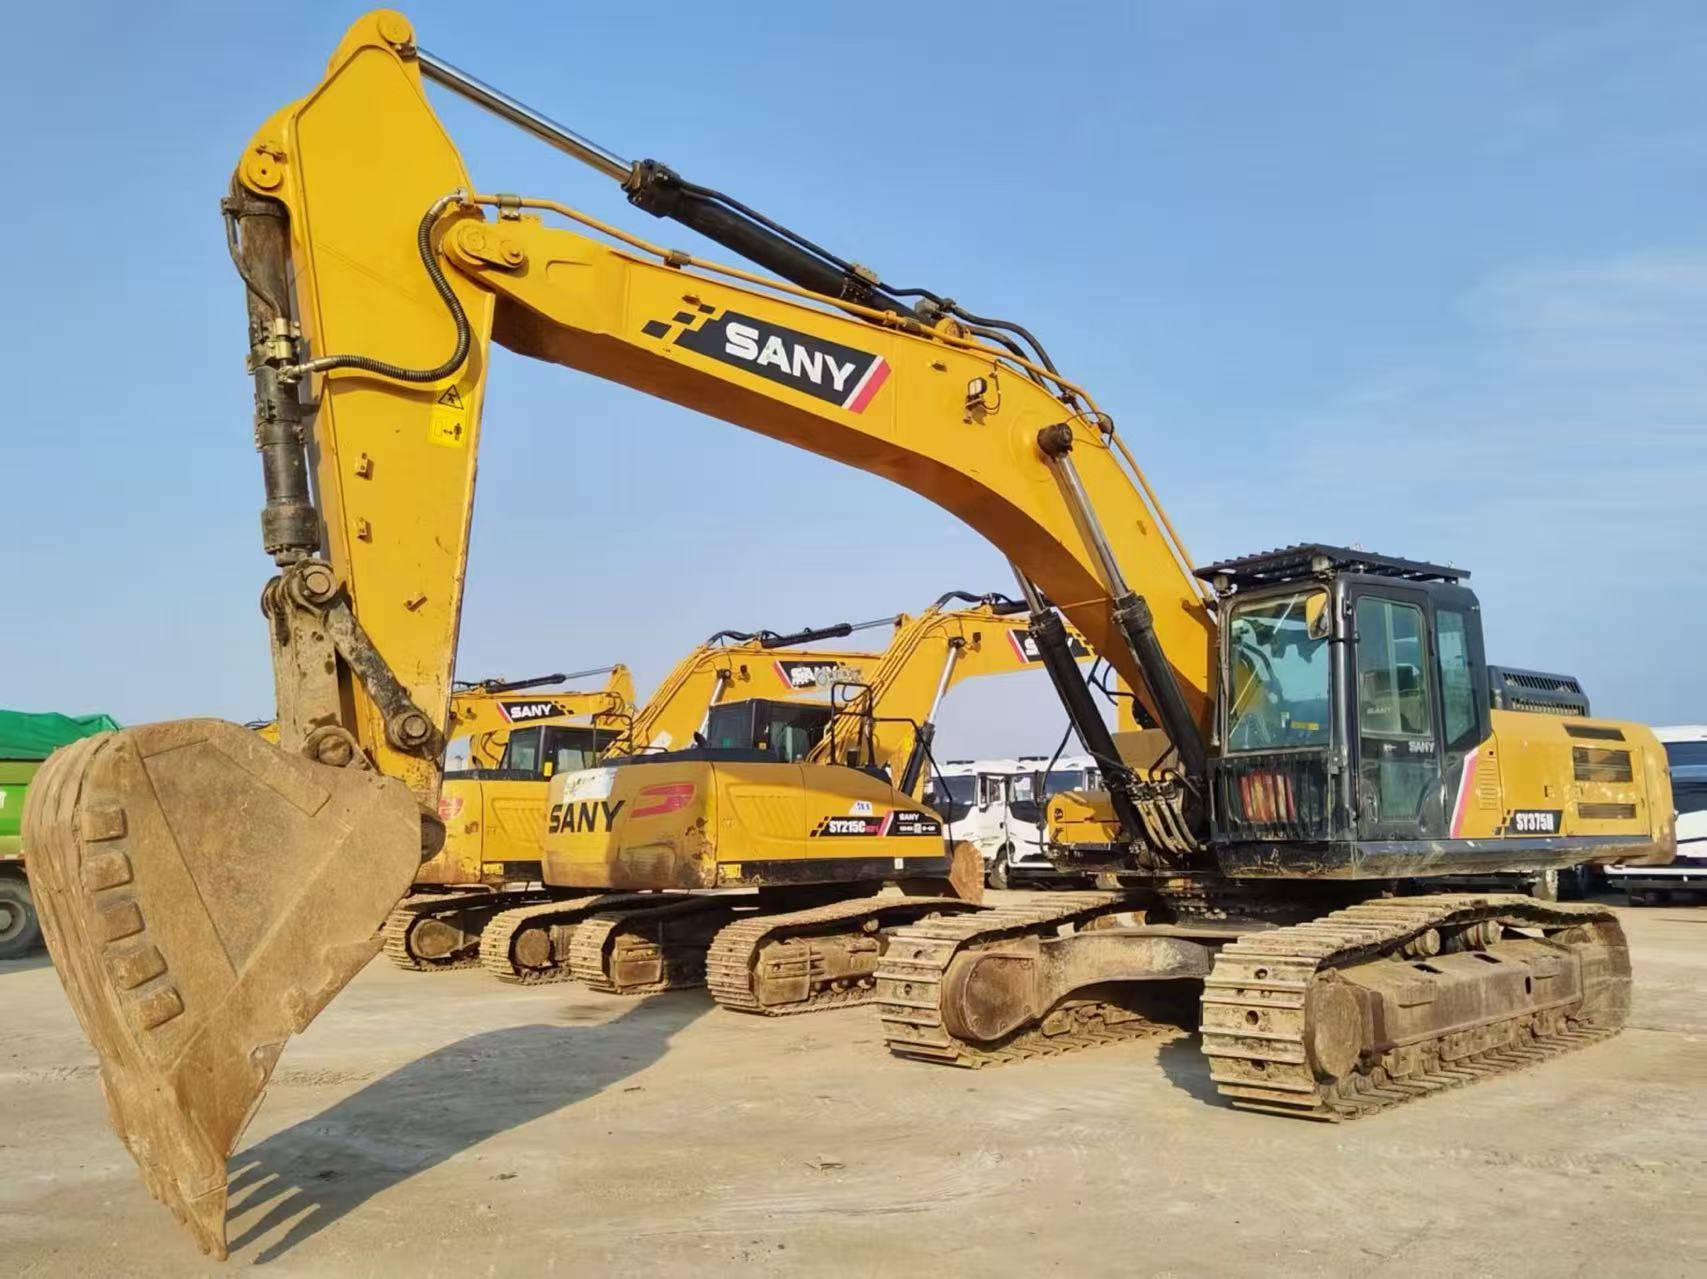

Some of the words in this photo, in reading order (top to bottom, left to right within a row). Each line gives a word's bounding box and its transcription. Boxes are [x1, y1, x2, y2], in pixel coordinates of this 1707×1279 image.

[725, 321, 856, 392] SANY
[510, 704, 552, 718] SANY
[1408, 741, 1435, 753] SANY
[549, 800, 626, 833] SANY
[898, 813, 920, 821] SANY
